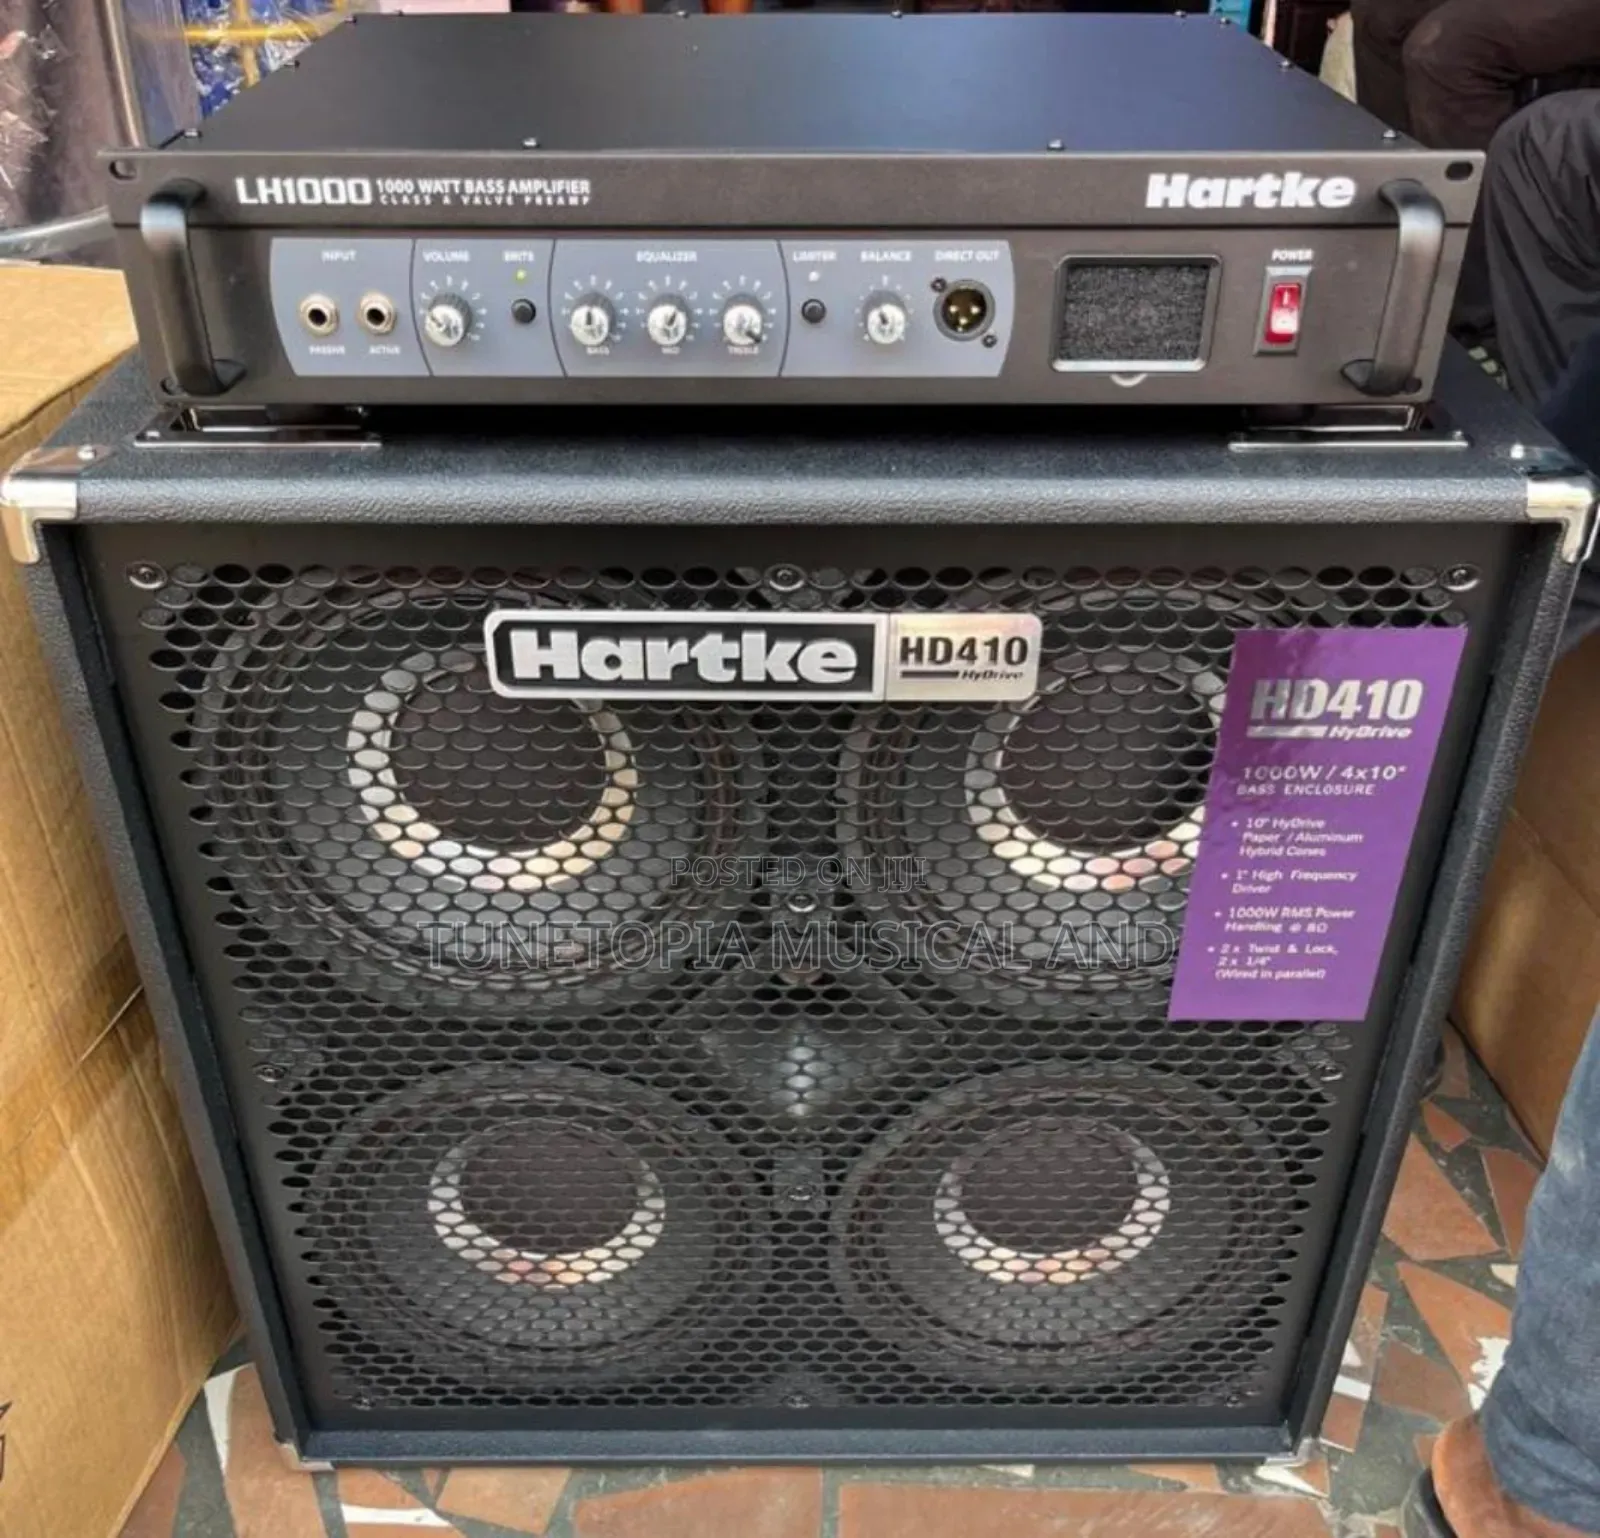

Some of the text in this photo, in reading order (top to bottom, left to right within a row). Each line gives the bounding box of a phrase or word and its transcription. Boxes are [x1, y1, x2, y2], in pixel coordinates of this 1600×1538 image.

[235, 177, 372, 205] LH1000
[376, 178, 591, 194] 1000 WATT BASS AMPLIFIER
[1145, 172, 1357, 209] Hartke
[379, 194, 432, 206] CLASS
[442, 194, 452, 206] A
[461, 194, 514, 206] VALVE
[321, 250, 357, 262] INPUT
[422, 250, 471, 263] VOLUME
[636, 251, 698, 263] EQUALIZER
[792, 251, 837, 262] LIMITER
[860, 251, 912, 262] BALANCE
[935, 250, 1000, 262] DIRECT OUT
[1271, 249, 1314, 262] POWER
[509, 629, 858, 684] Hartke
[900, 636, 1028, 666] HD410
[960, 668, 1024, 681] HyDrive
[1250, 678, 1424, 721] HD410
[1328, 725, 1413, 741] HyDrive
[1243, 765, 1323, 780] 1000W
[1236, 784, 1376, 796] BASS ENCLOSURE
